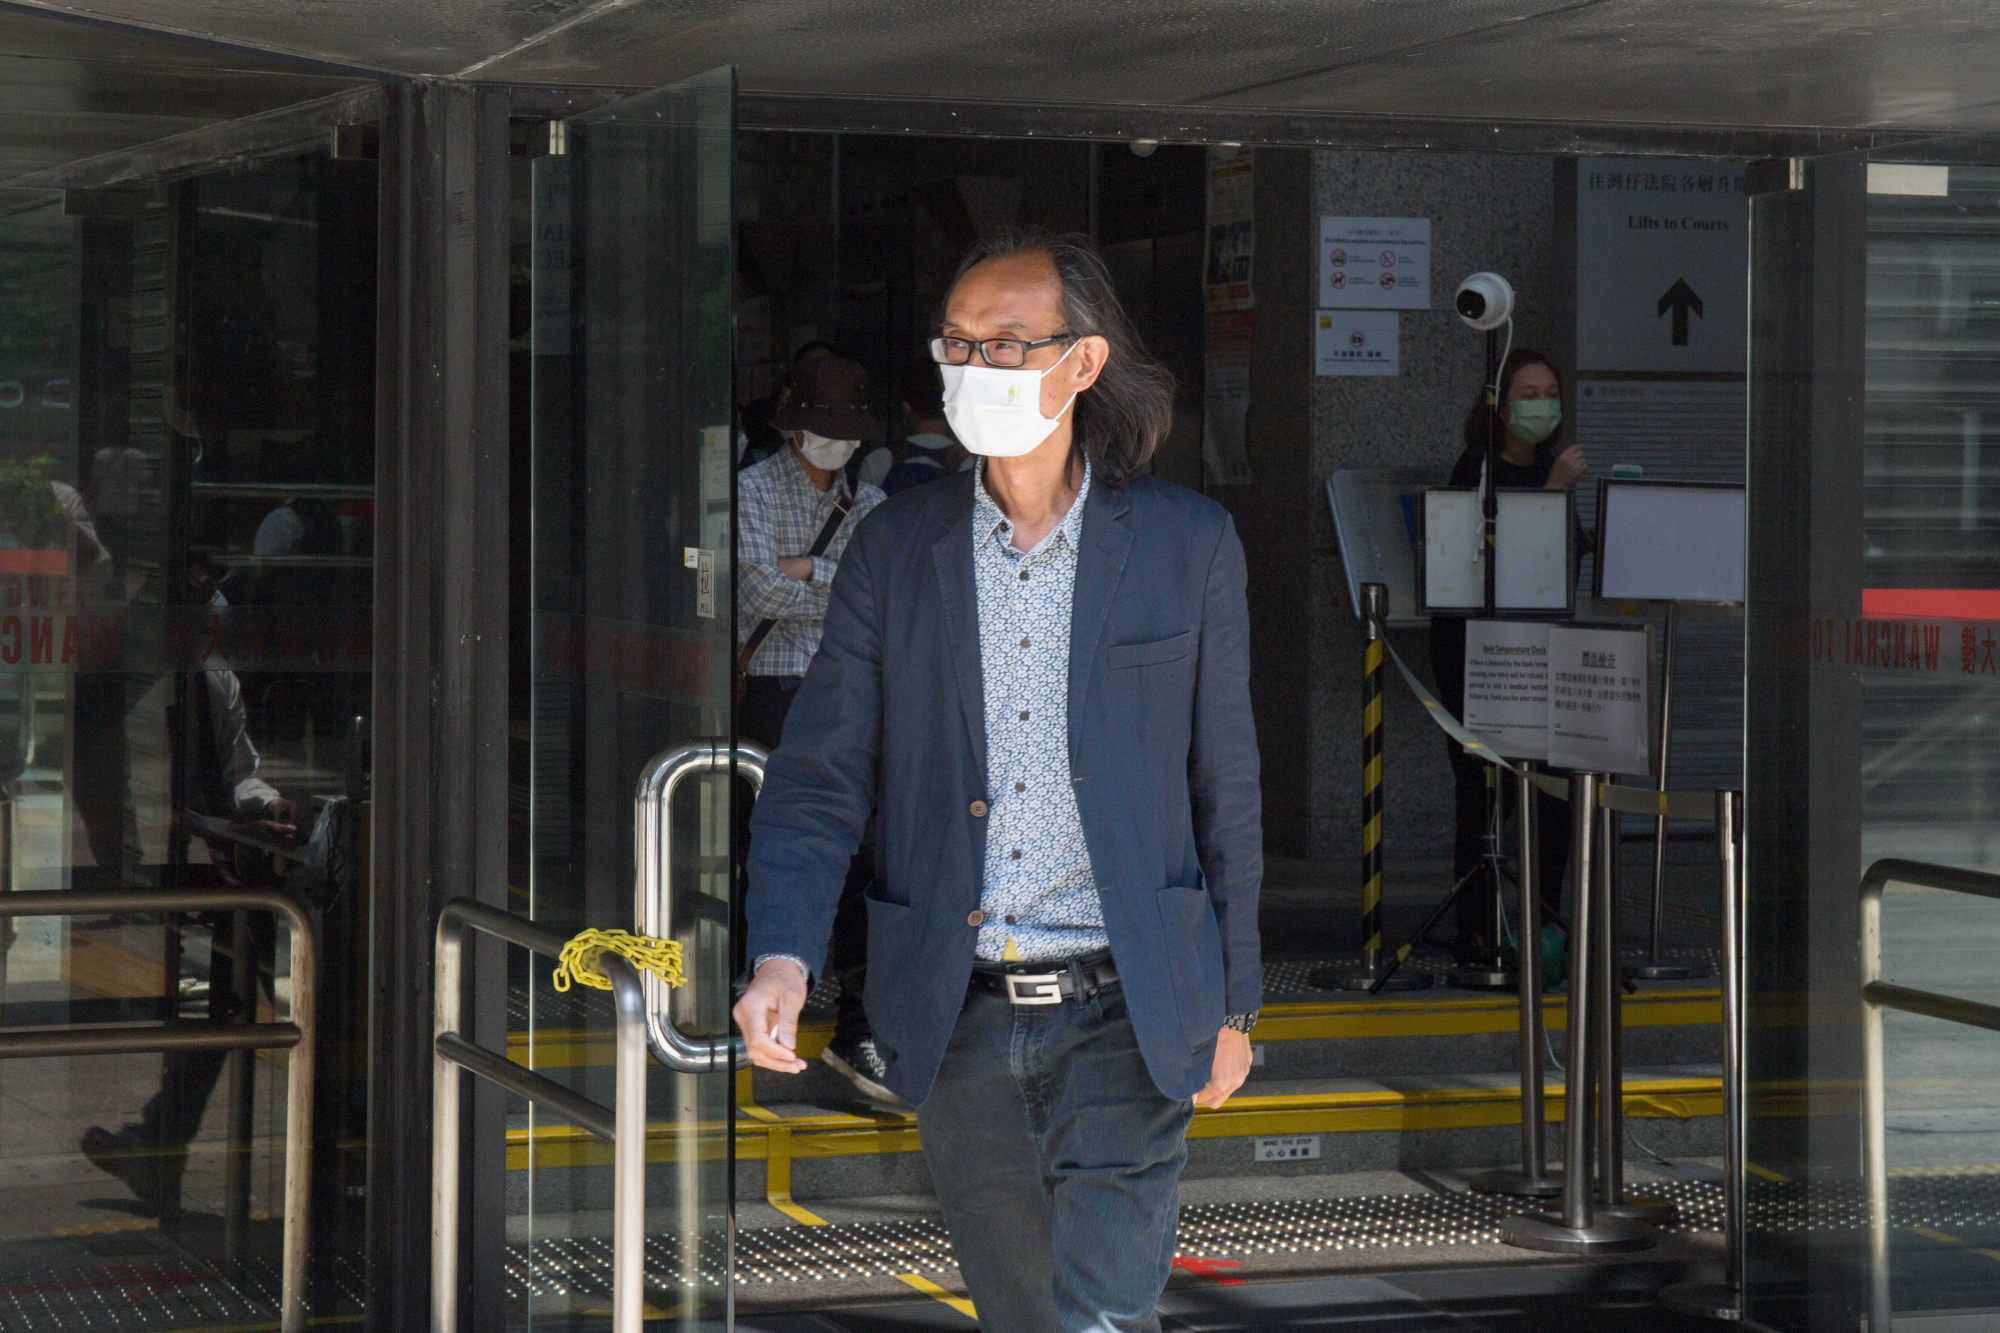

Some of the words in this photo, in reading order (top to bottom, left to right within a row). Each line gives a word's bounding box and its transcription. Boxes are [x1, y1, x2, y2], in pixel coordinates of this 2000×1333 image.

[1628, 215, 1660, 230] Lifts
[1664, 216, 1678, 230] to
[1682, 216, 1729, 231] Courts
[1496, 646, 1530, 655] Temperature
